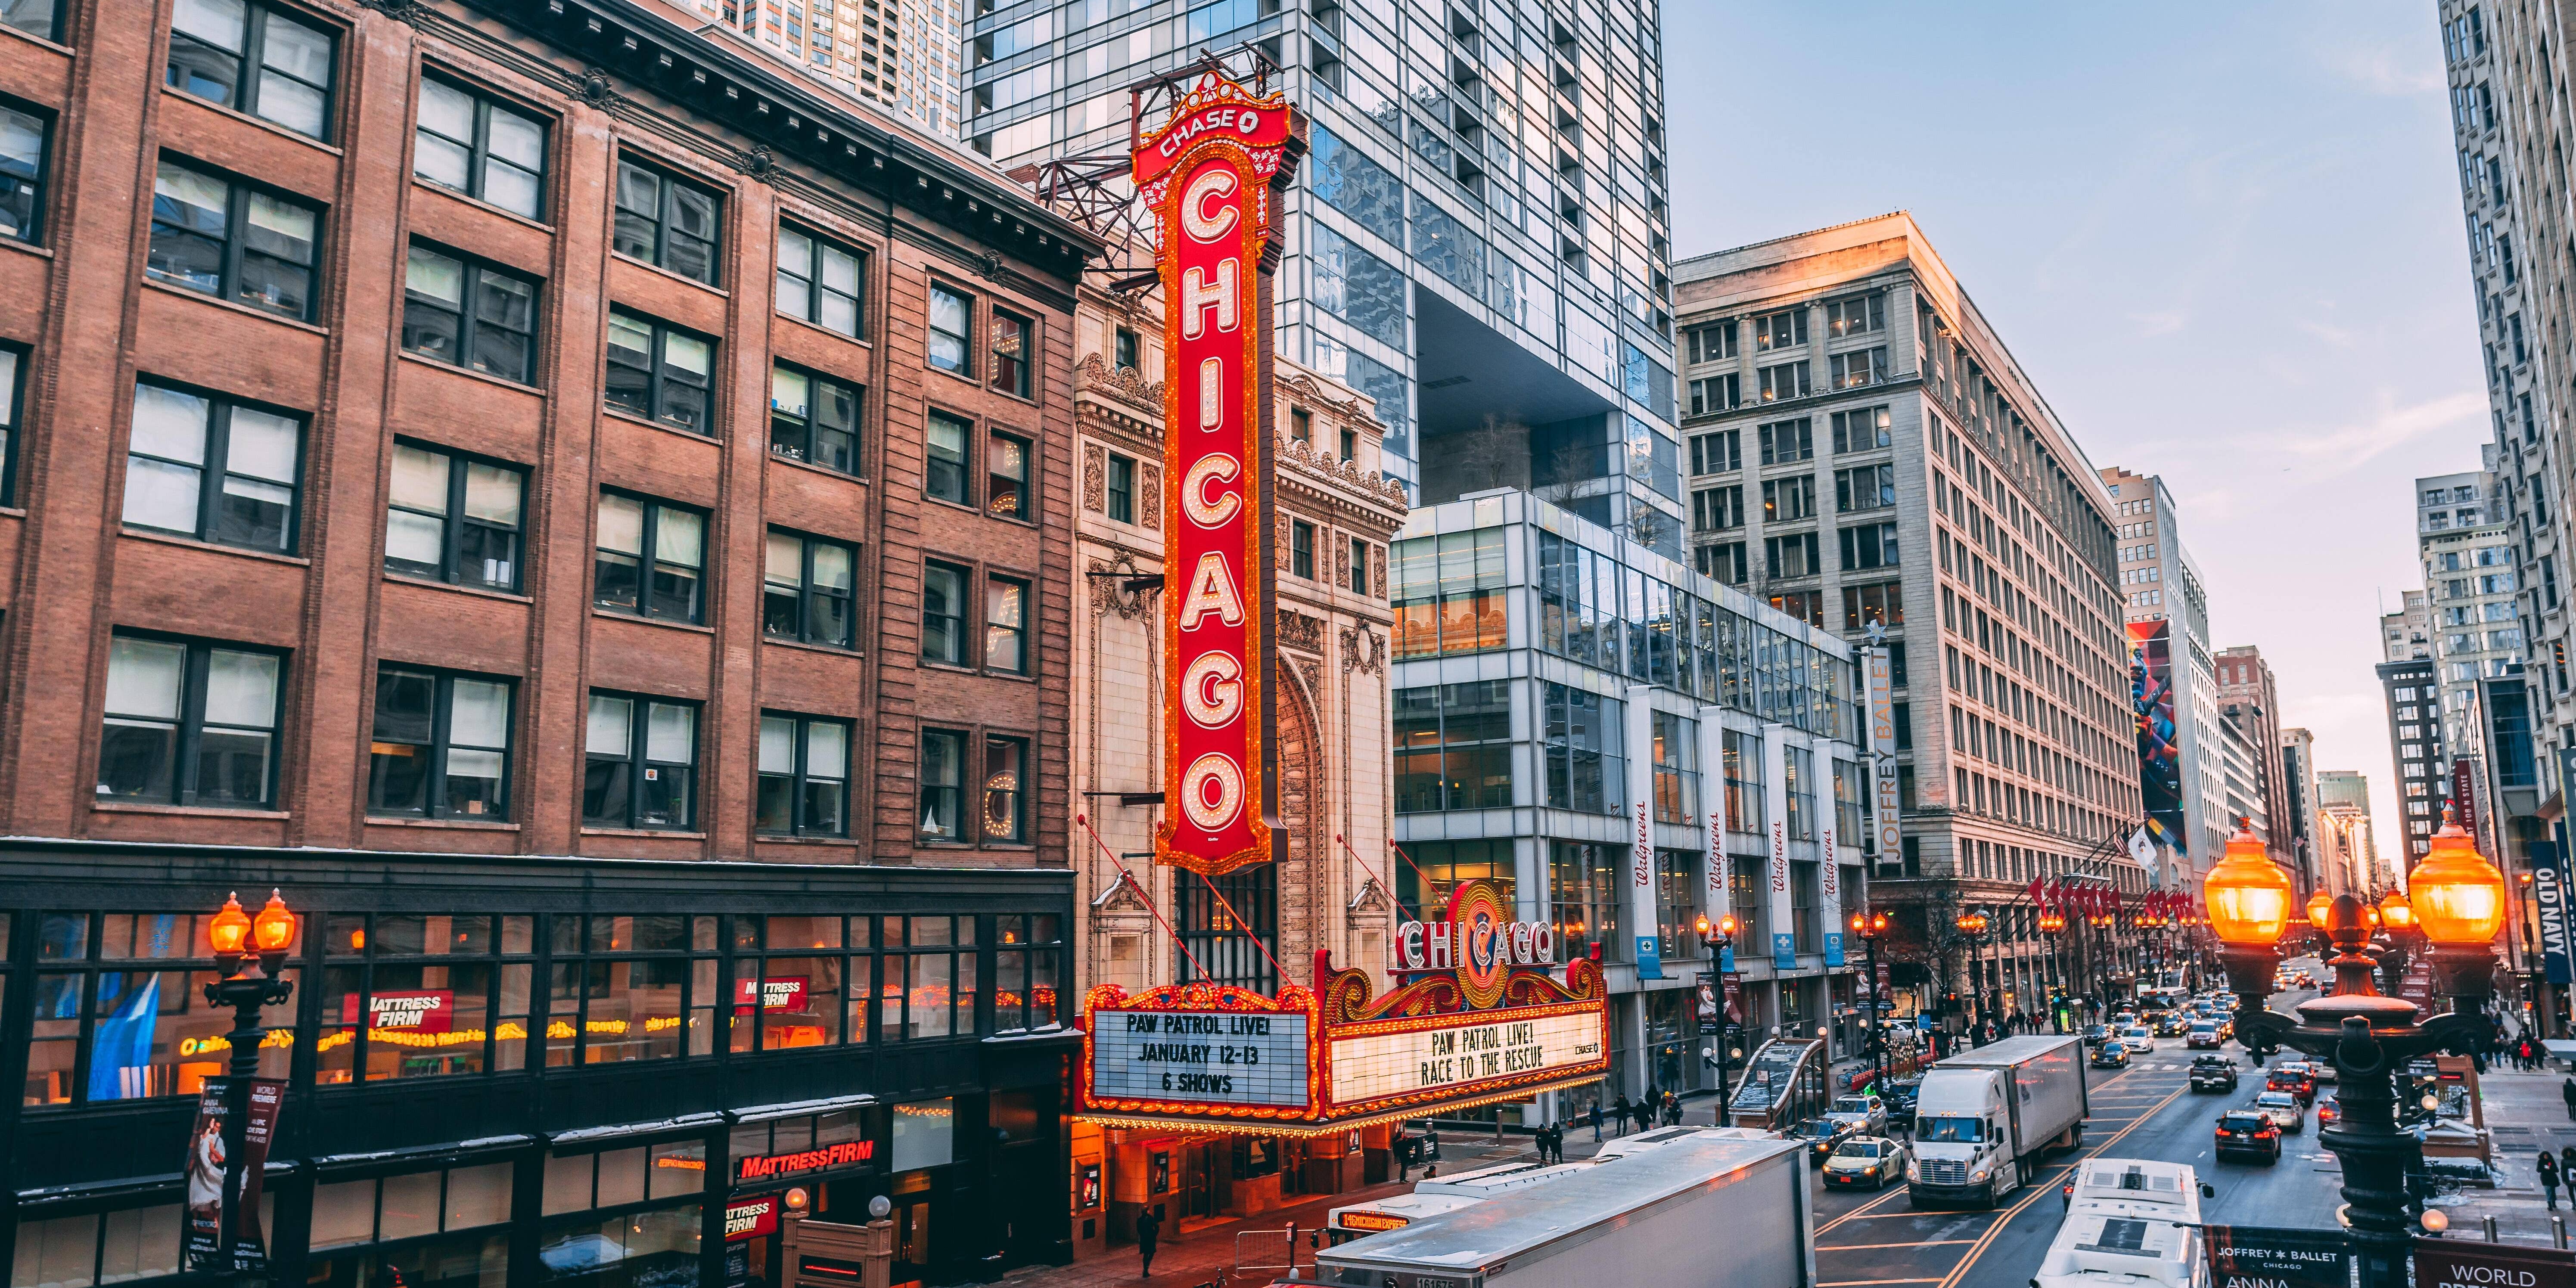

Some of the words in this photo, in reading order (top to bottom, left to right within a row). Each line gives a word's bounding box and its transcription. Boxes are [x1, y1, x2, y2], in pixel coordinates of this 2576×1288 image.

[1160, 109, 1236, 158] CHASE
[1180, 169, 1245, 832] CHICAGO
[1871, 650, 1892, 739] BALLET
[2460, 775, 2470, 797] STATE
[1877, 748, 1901, 860] JOFFREY
[1636, 801, 1652, 888] Walgreens
[1710, 812, 1726, 891] Walgreens
[1773, 821, 1788, 893] Walgreens
[1825, 829, 1838, 896] Walgreens
[2536, 868, 2557, 904] OLD
[1400, 920, 1553, 968] CHICAGO
[2542, 907, 2566, 956] NAVY
[746, 982, 800, 994] MTTRESS
[376, 1010, 424, 1027] FIRM
[1127, 1014, 1159, 1033] PAW
[1164, 1015, 1223, 1034] PATROL
[1231, 1016, 1270, 1036] LIVE!
[1432, 1031, 1455, 1056] PAW
[1463, 1026, 1501, 1053] PATROL
[1507, 1022, 1534, 1046] LIVE!
[1575, 1045, 1593, 1055] CHASE
[1137, 1043, 1211, 1063] JANUARY
[1220, 1045, 1258, 1065] 12-13
[1421, 1058, 1453, 1086] RACE
[1460, 1055, 1474, 1079] TO
[1480, 1052, 1500, 1076] THE
[1505, 1046, 1543, 1072] RESCUE
[1162, 1072, 1171, 1091] 6
[1177, 1073, 1233, 1093] SHOWS
[725, 1216, 758, 1233] FIRM
[726, 1202, 770, 1220] TTRESS
[1356, 1216, 1382, 1228] MICHIGAN
[2219, 1248, 2271, 1259] JOFFREY
[2291, 1251, 2337, 1262] BALLET
[1418, 1278, 1454, 1288] 161675
[2451, 1264, 2536, 1287] WORLD
